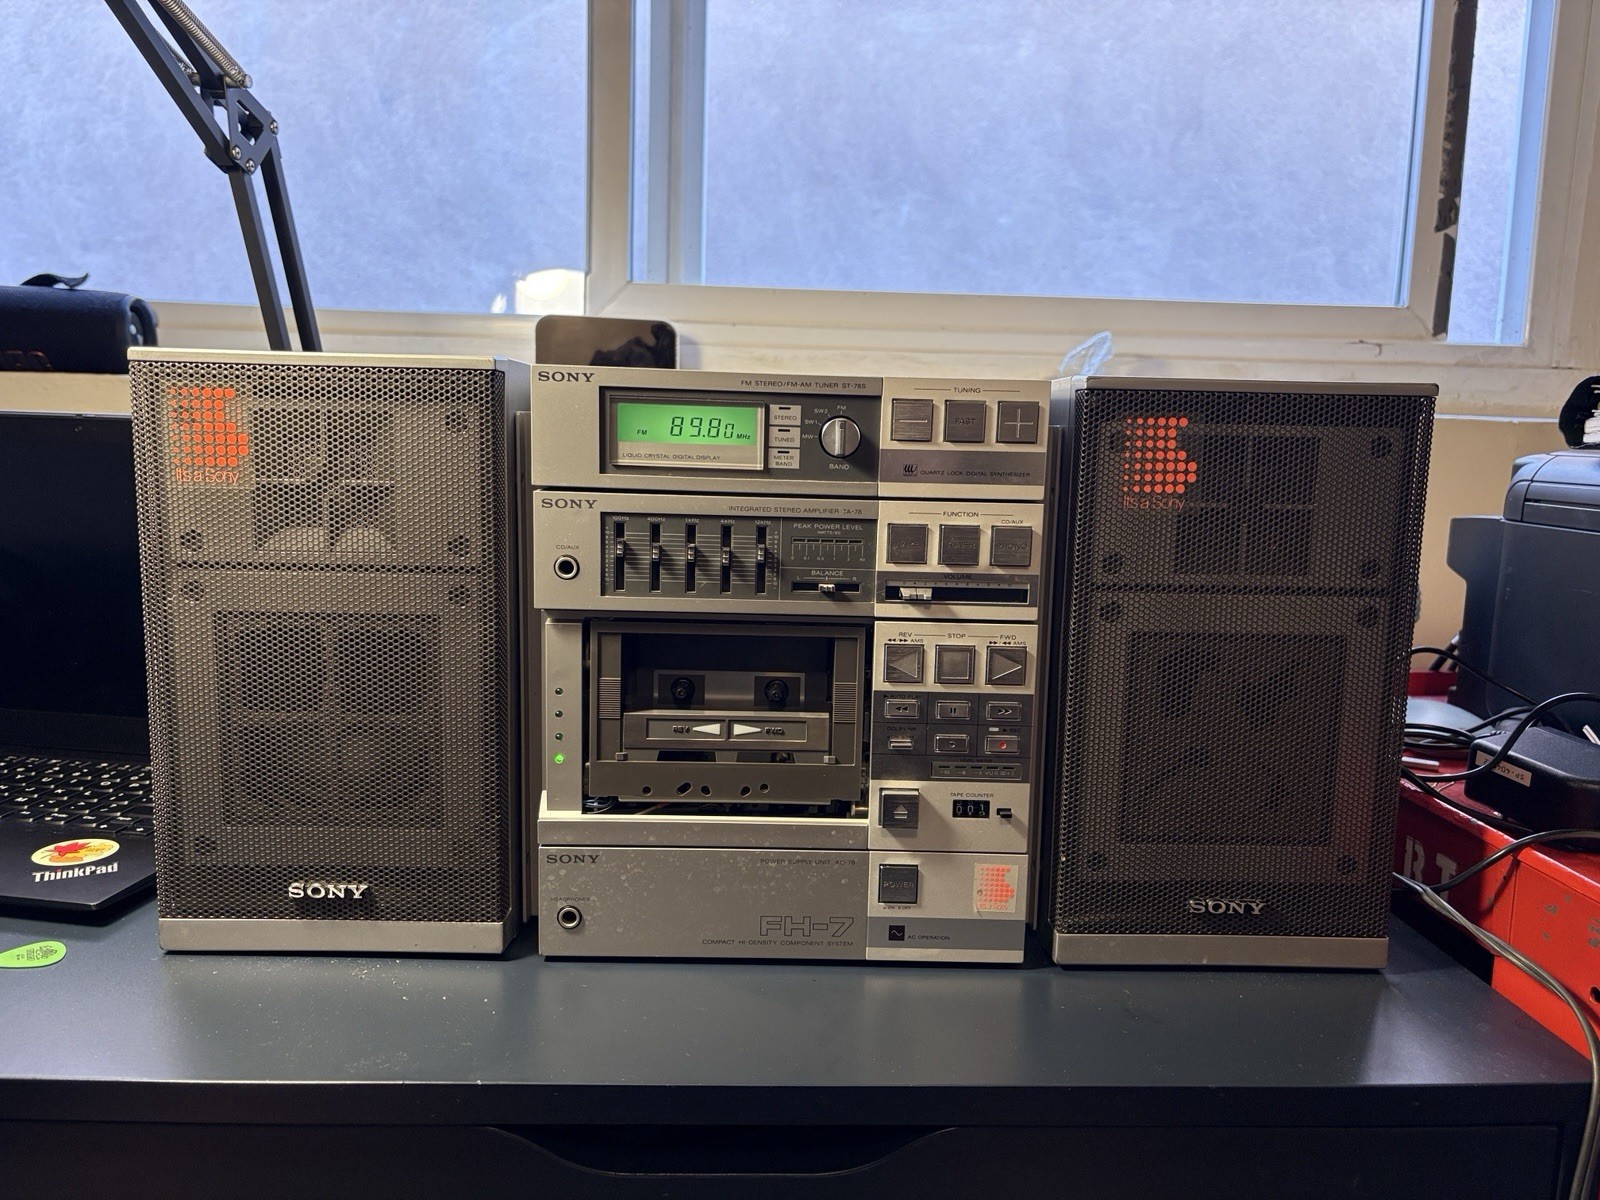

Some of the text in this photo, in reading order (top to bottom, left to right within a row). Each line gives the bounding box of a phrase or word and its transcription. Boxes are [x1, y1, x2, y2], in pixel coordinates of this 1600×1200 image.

[538, 371, 595, 383] SONY
[670, 416, 735, 439] 89.80
[193, 473, 202, 482] a
[205, 467, 239, 485] Sony
[541, 498, 597, 509] SONY
[728, 505, 772, 513] INTEGRATED
[774, 506, 801, 514] STEREO
[803, 507, 840, 515] AMPLIFIER
[1140, 500, 1149, 509] a
[1152, 495, 1186, 512] Sony
[546, 854, 600, 864] SONY
[32, 862, 119, 883] ThinkPad
[288, 882, 369, 899] SONY
[1189, 899, 1267, 915] SONY
[760, 915, 854, 938] FH-7
